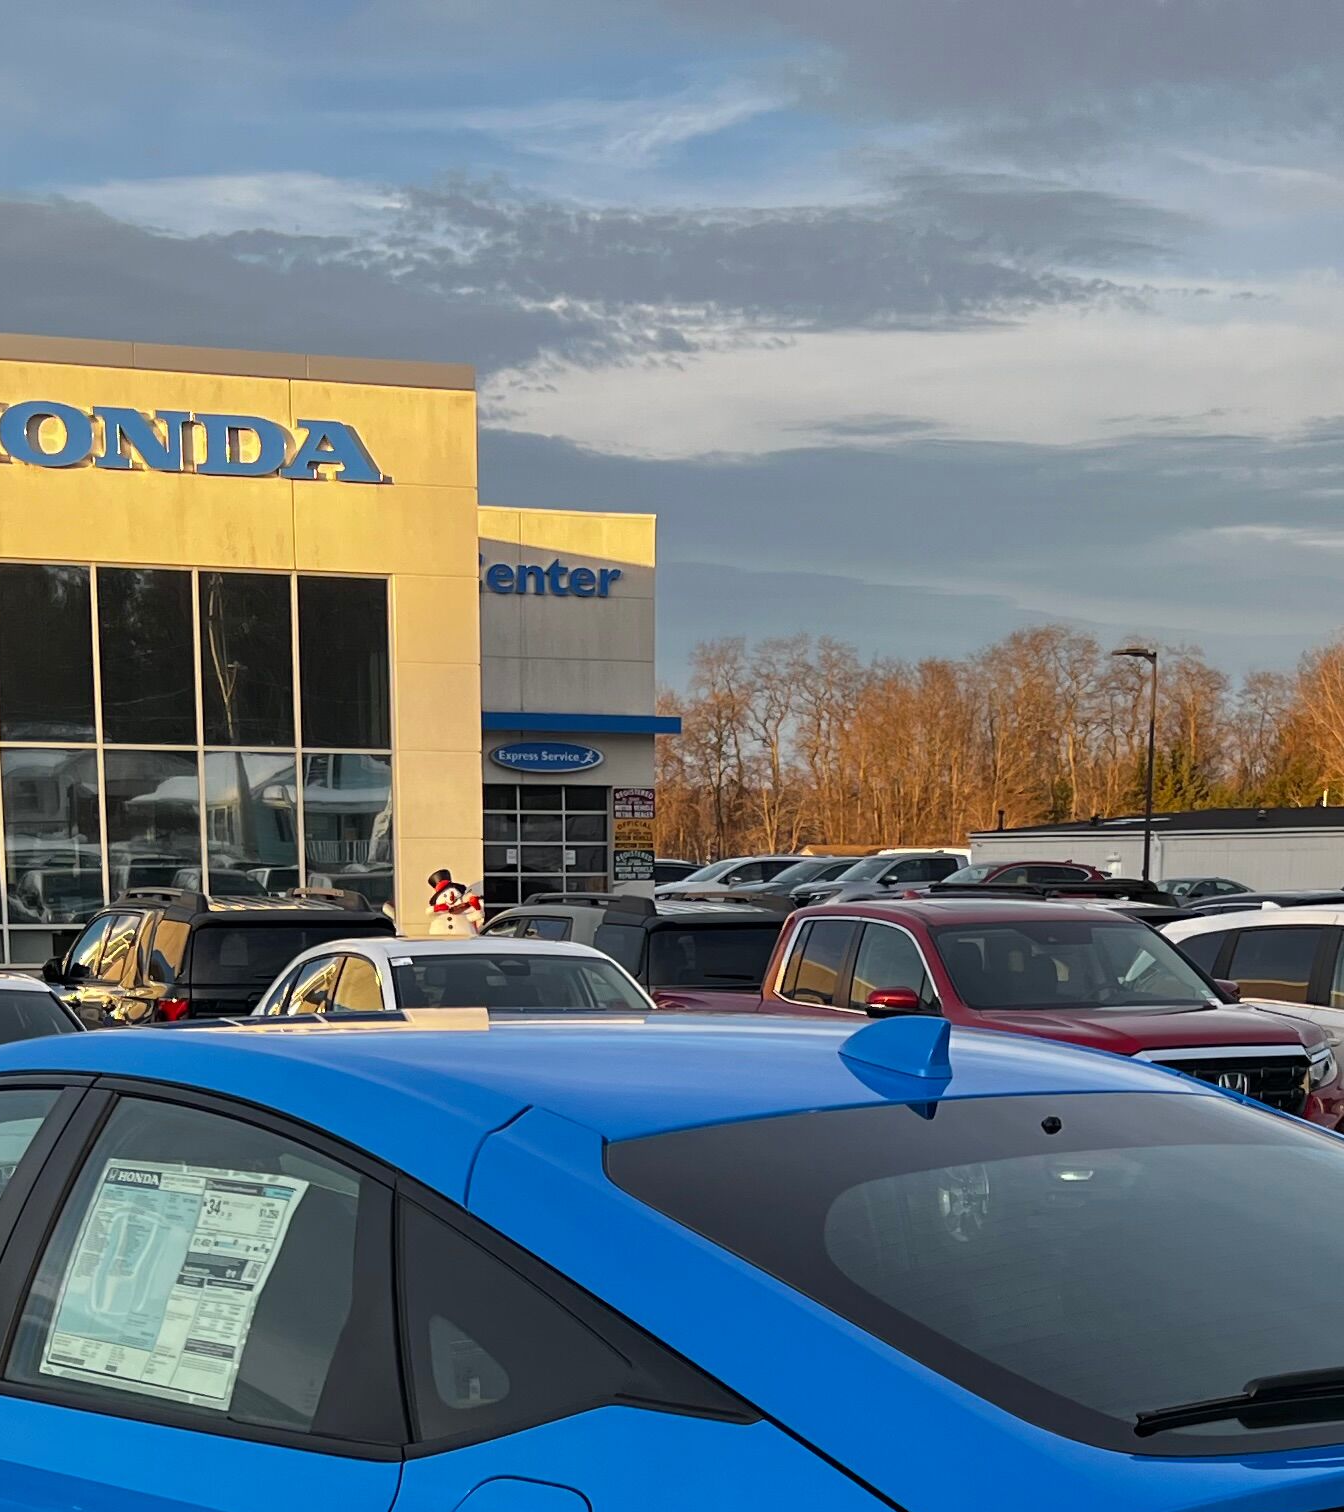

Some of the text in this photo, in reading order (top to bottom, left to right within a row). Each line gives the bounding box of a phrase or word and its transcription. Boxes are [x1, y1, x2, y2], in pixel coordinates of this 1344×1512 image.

[479, 553, 622, 598] enter
[498, 750, 580, 762] Express Service
[118, 1171, 159, 1185] HONDA
[207, 1198, 222, 1215] 34
